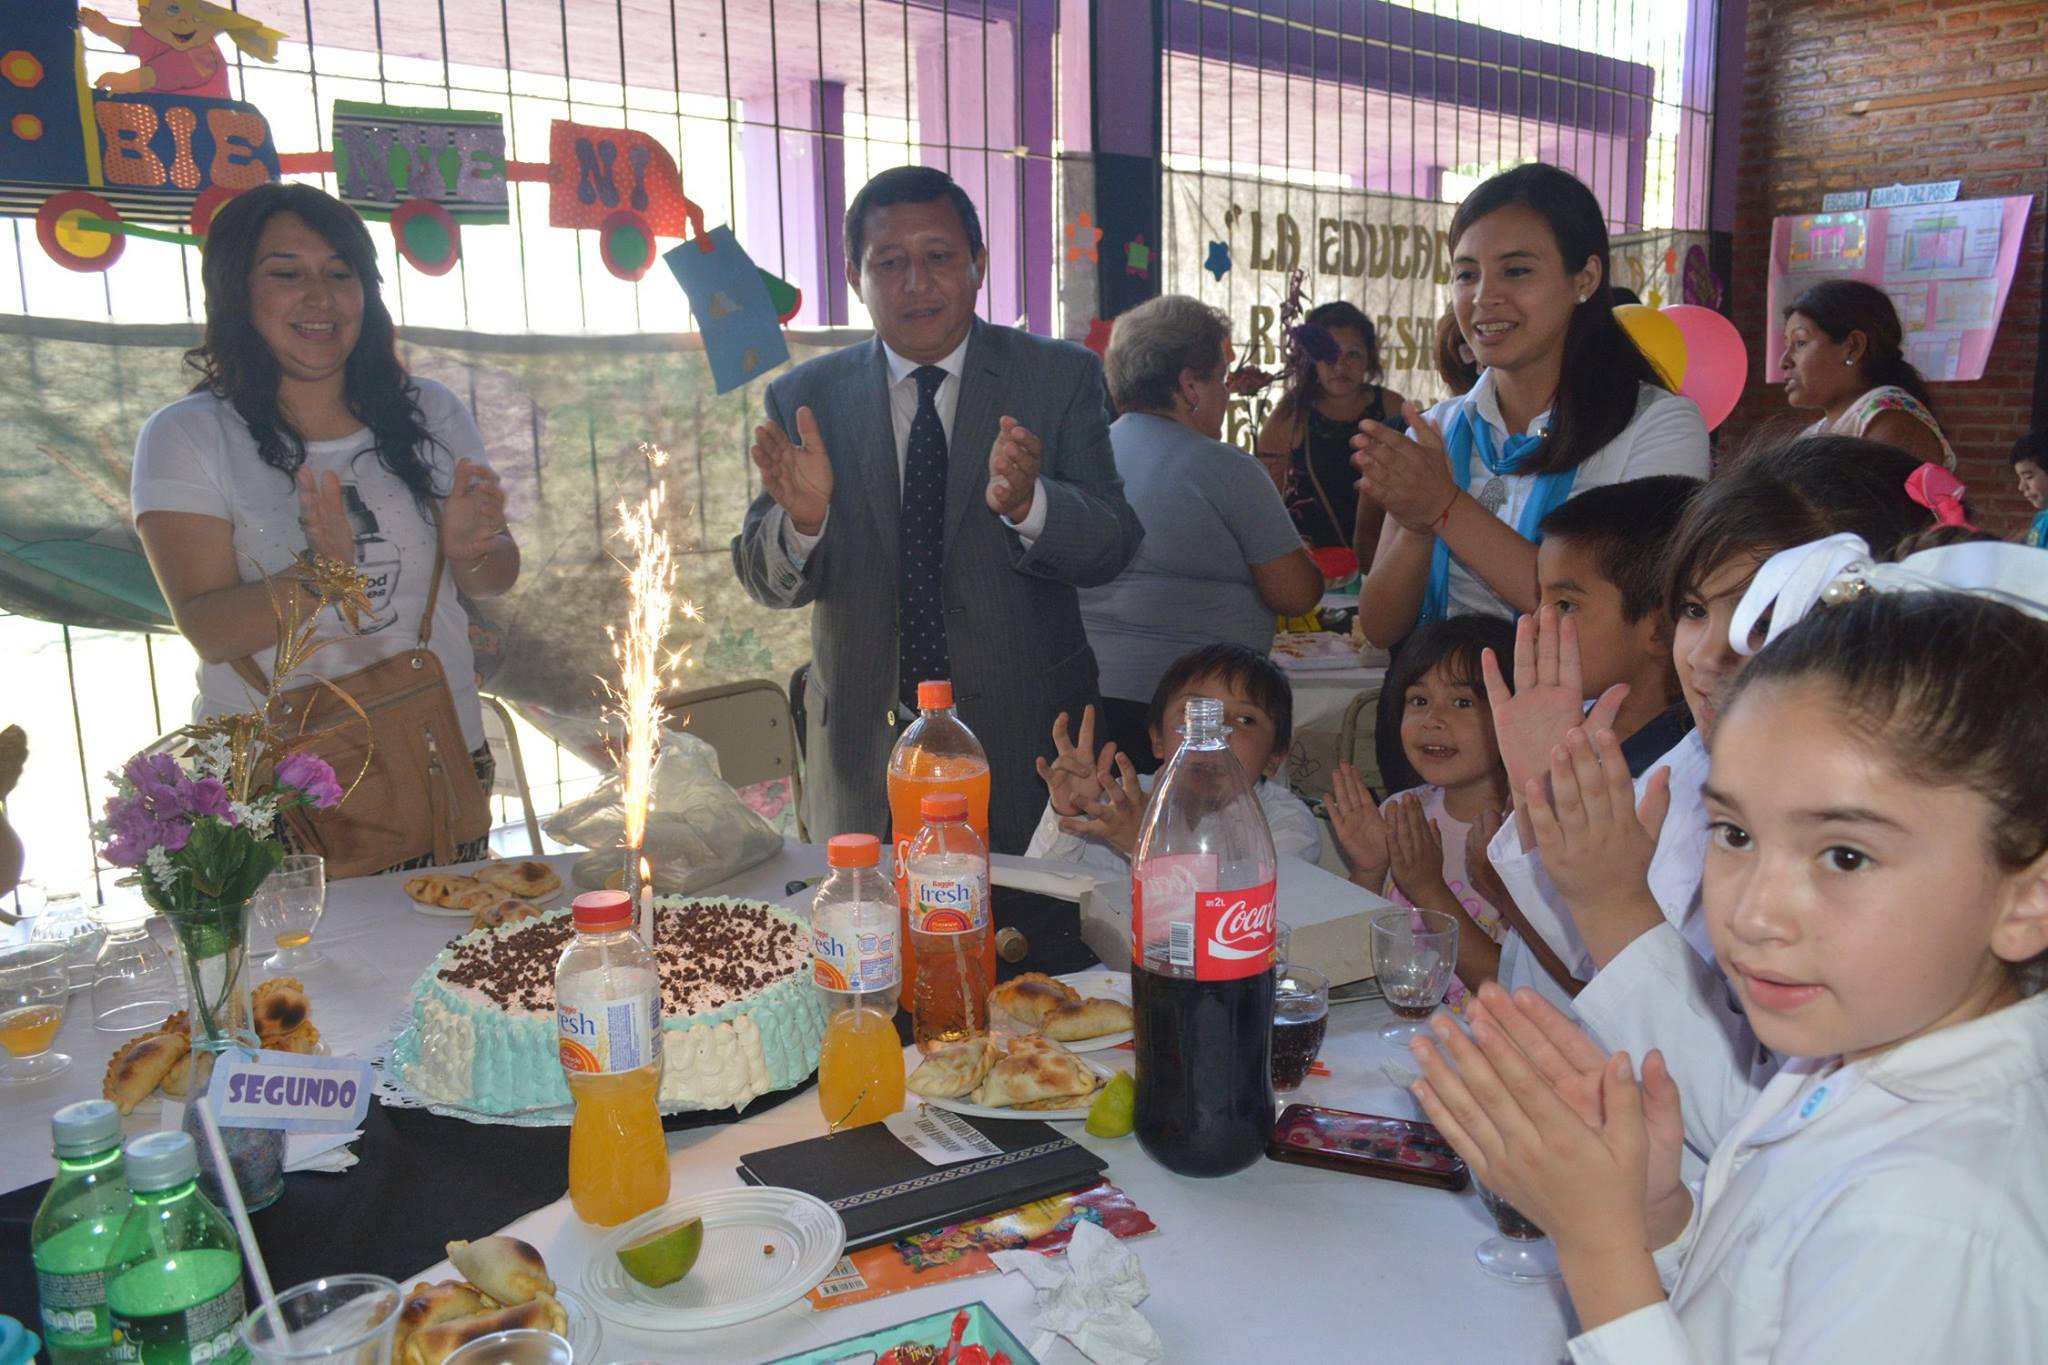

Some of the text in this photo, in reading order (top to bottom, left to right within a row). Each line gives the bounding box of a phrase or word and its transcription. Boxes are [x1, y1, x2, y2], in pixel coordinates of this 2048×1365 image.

[95, 100, 269, 189] BIE
[576, 138, 650, 211] NI
[1319, 217, 1450, 285] EDUCAC
[921, 884, 970, 904] fresh
[229, 1073, 357, 1109] SEGUNDO
